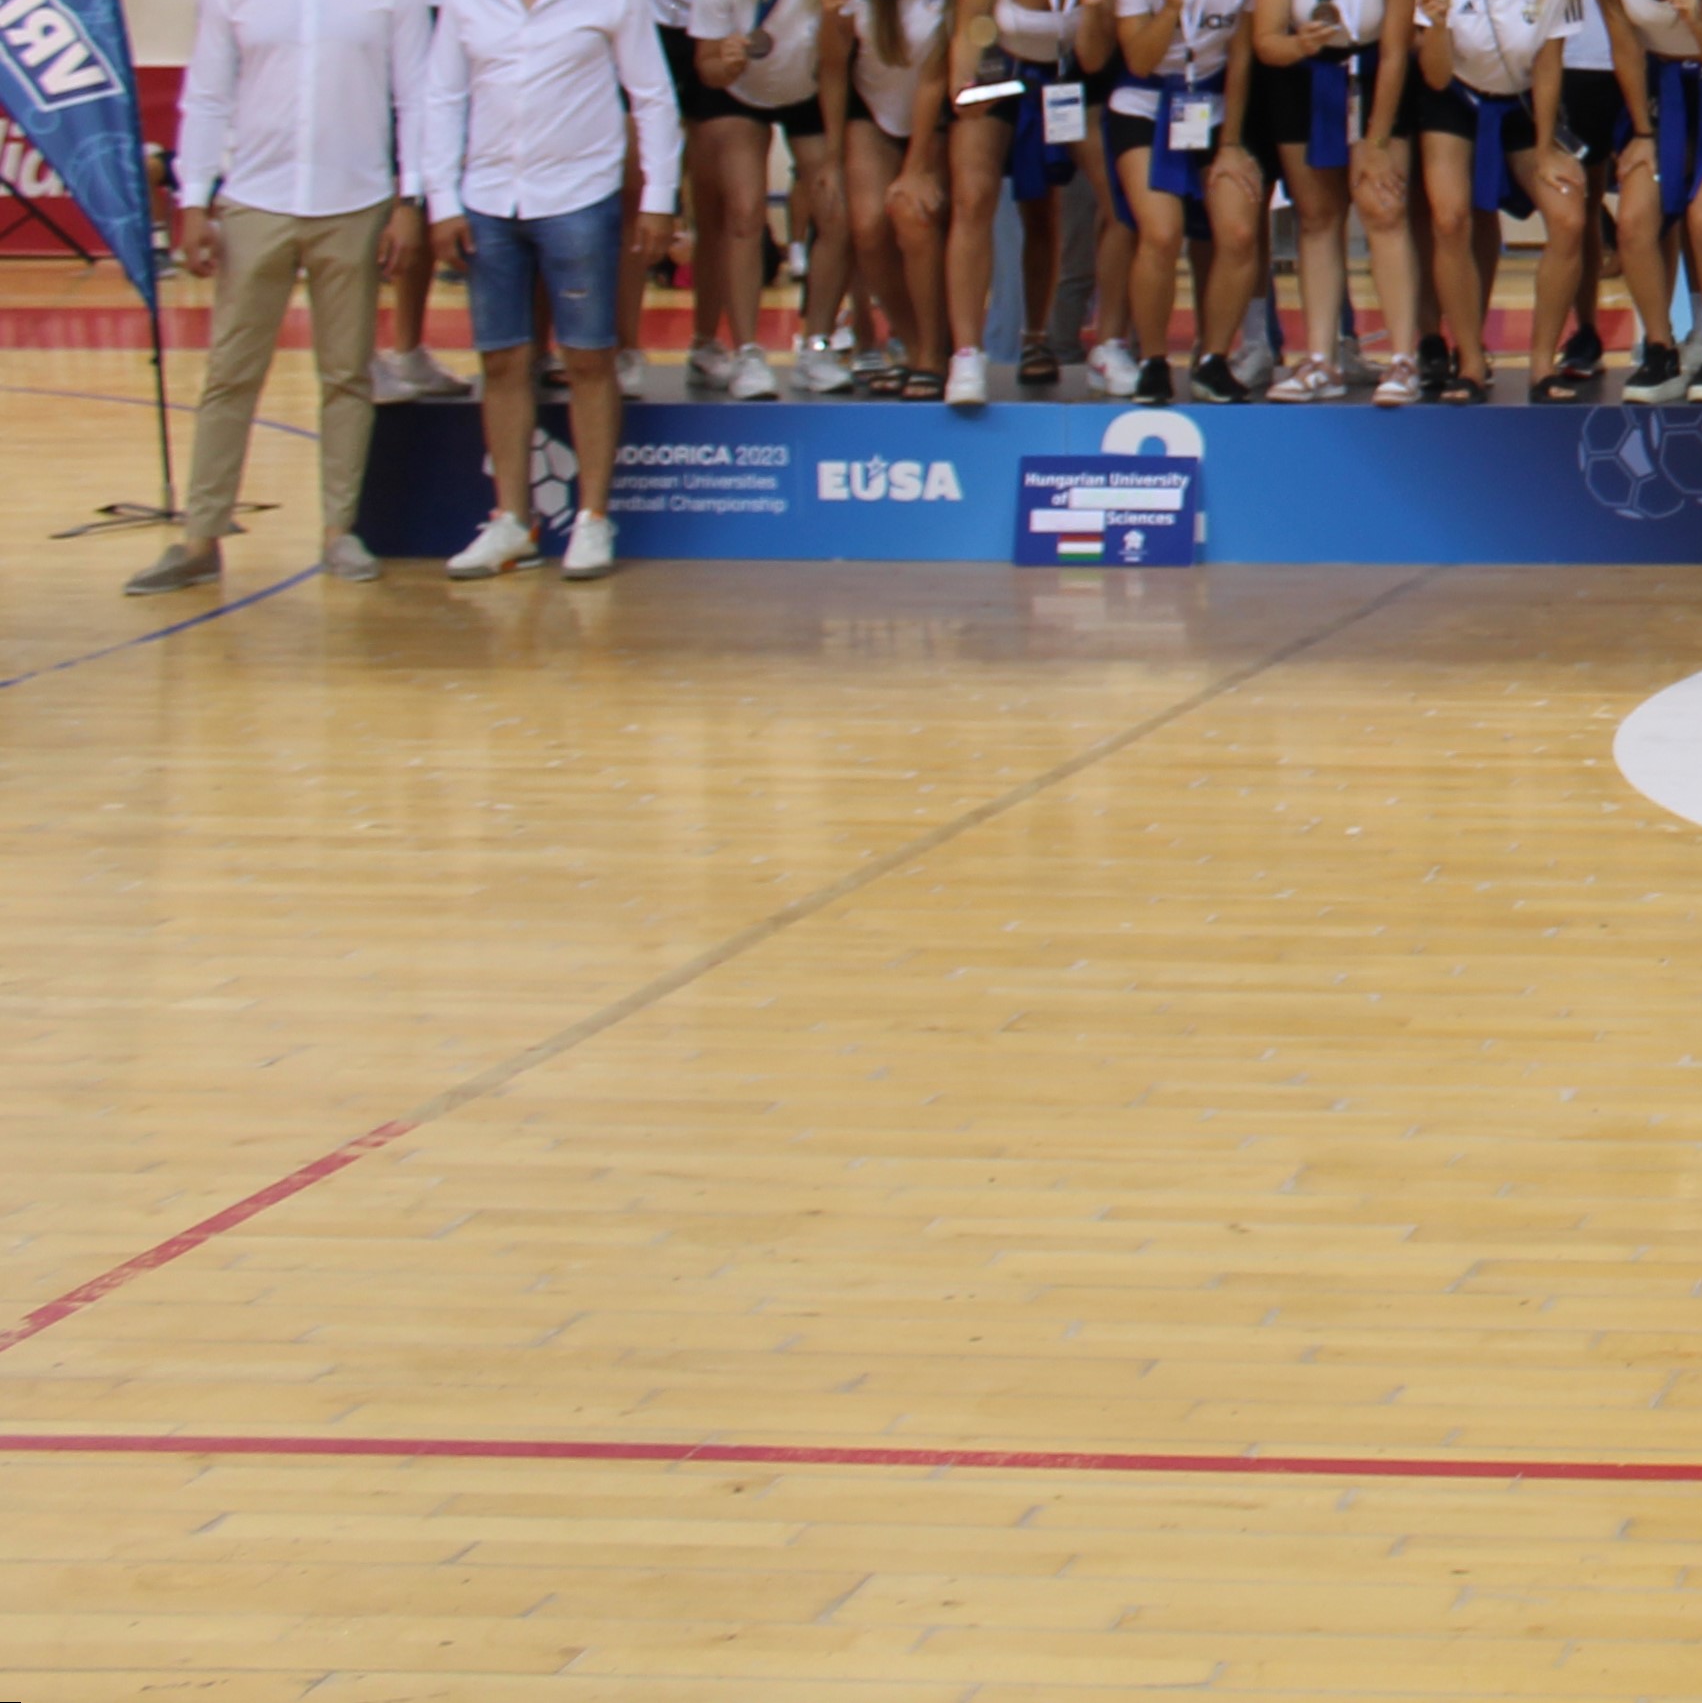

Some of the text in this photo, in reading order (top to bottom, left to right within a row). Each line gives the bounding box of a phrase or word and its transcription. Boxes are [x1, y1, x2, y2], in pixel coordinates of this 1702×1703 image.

[734, 446, 790, 466] 2023
[611, 473, 778, 490] uropean Universities
[817, 453, 963, 501] EUSA
[1024, 471, 1190, 489] Hungarian University
[608, 495, 788, 514] andball Championship
[1105, 512, 1175, 526] Sciences
